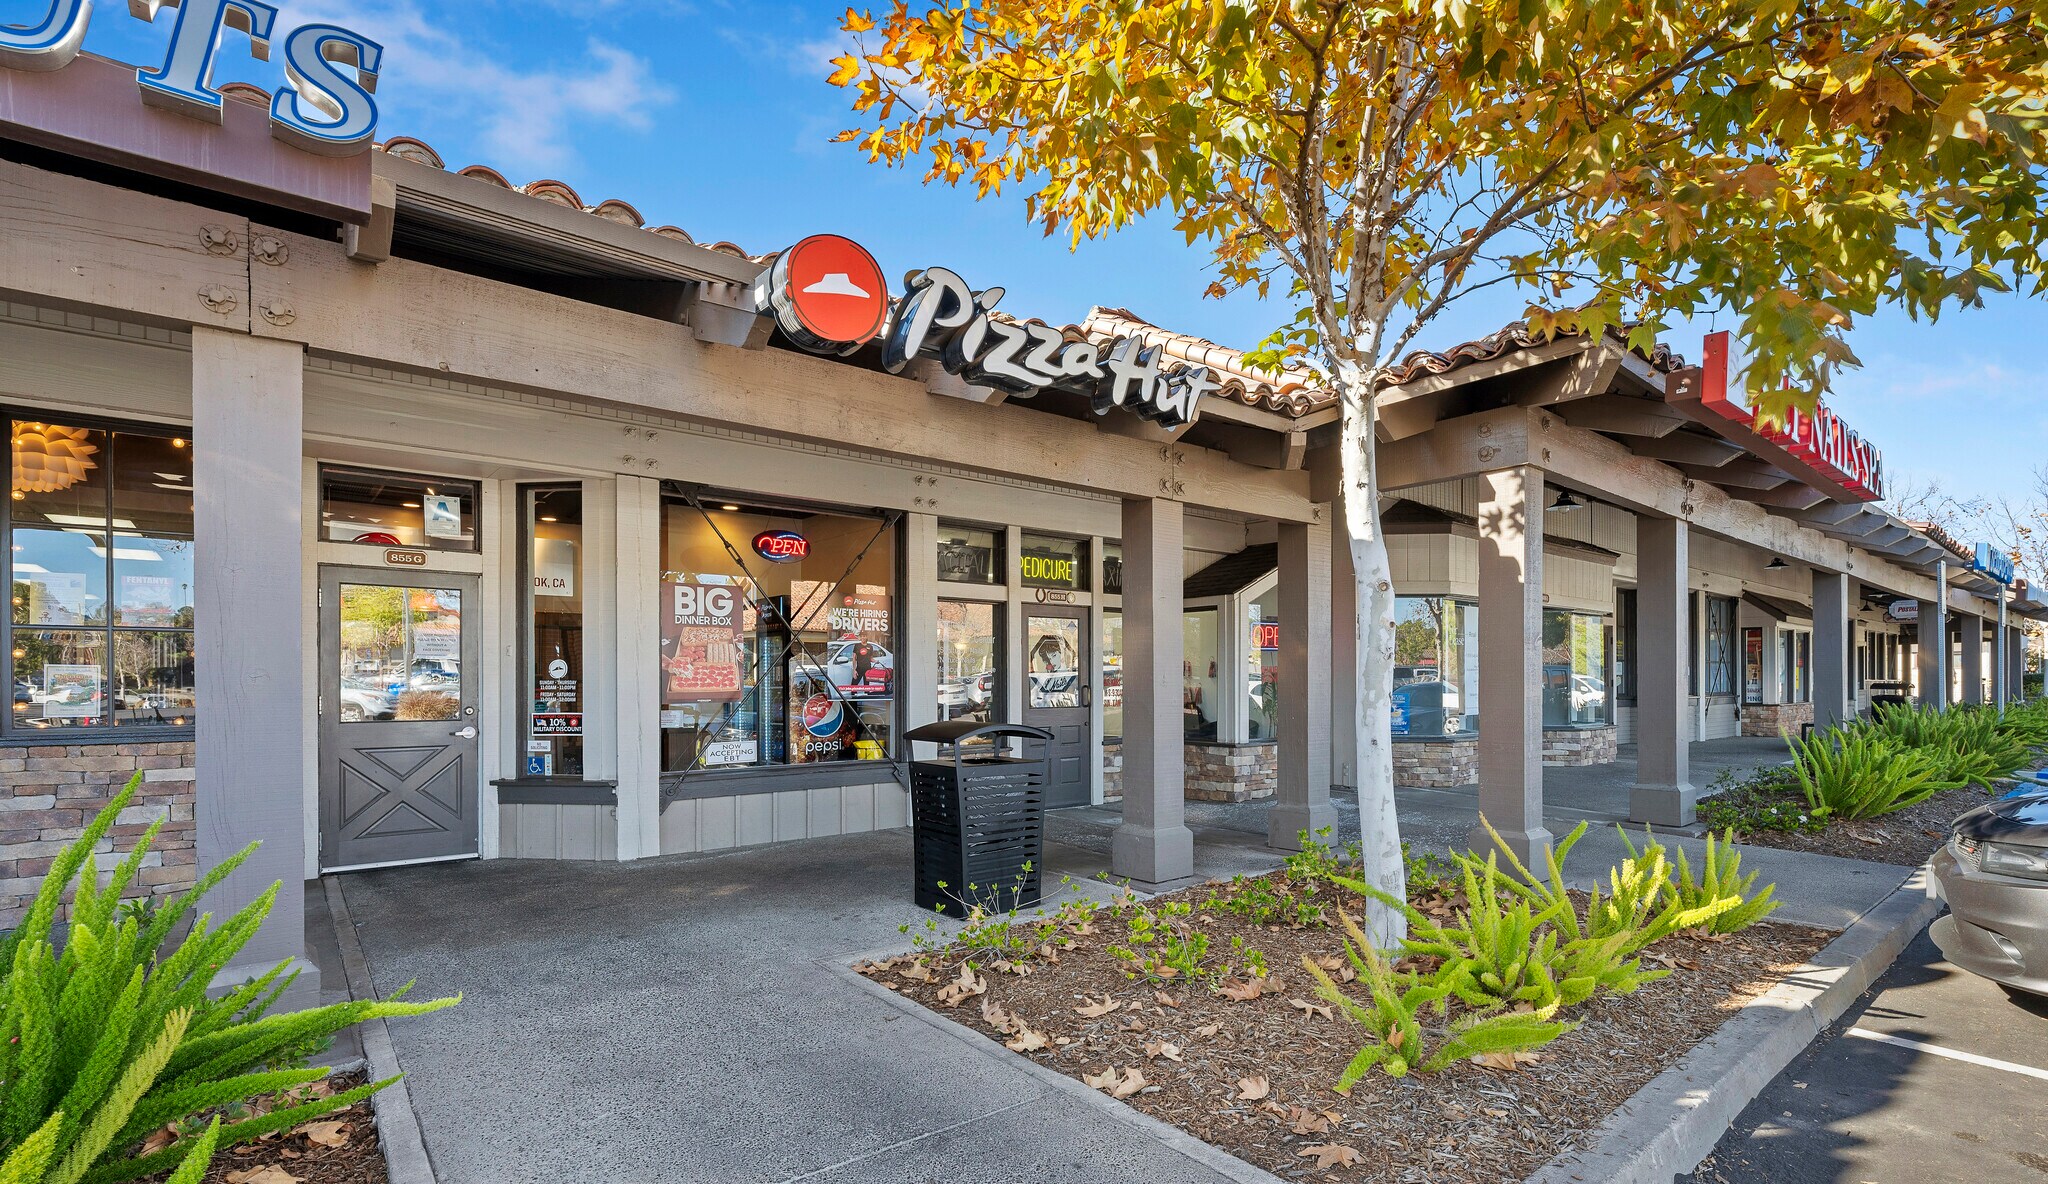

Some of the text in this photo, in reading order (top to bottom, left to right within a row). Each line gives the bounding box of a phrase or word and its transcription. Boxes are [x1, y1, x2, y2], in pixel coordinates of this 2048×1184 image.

[893, 266, 1222, 426] Pizza Hut
[1808, 397, 1859, 482] NAILS
[1860, 438, 1886, 501] SPA
[758, 536, 807, 555] OPEN
[390, 553, 423, 563] 855 G
[552, 578, 566, 588] CA
[674, 585, 734, 617] BIG
[674, 615, 733, 626] DINNER BOX
[832, 607, 889, 619] WE'RE HIRING
[831, 617, 889, 632] DRIVERS
[1253, 626, 1279, 647] OPE
[549, 718, 567, 726] 10%
[709, 749, 754, 757] ACCEPTING
[805, 738, 843, 755] pepsi
